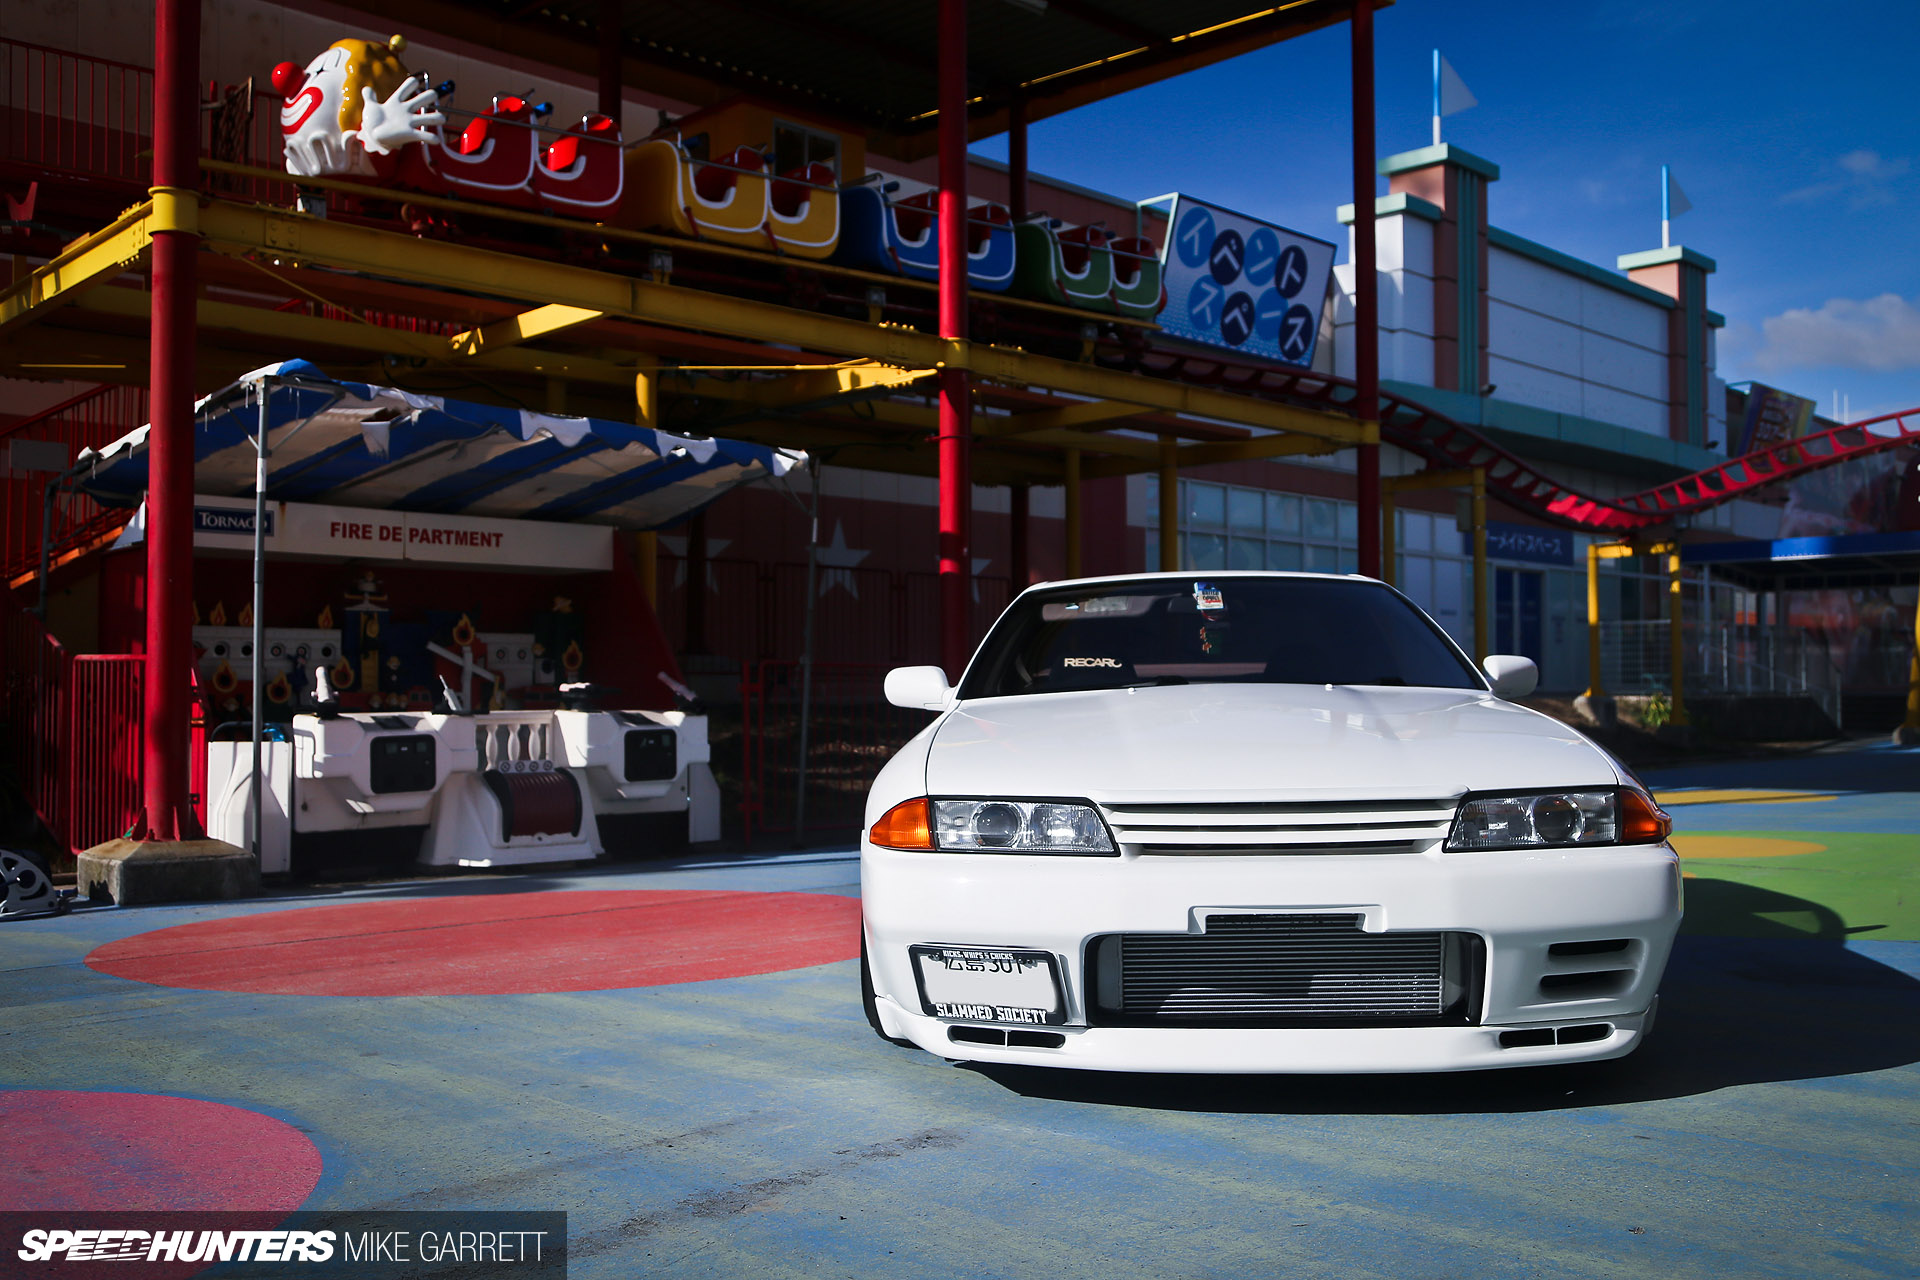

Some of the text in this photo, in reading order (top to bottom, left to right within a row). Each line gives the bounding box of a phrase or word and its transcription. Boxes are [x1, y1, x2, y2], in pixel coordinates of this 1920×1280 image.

[1182, 216, 1302, 291] イベント
[1191, 280, 1307, 352] スペース
[330, 521, 372, 540] FIRE
[963, 951, 984, 959] WHIPS
[990, 952, 1014, 960] CHICKS
[936, 1003, 1047, 1024] SLAMMED SOCIETY
